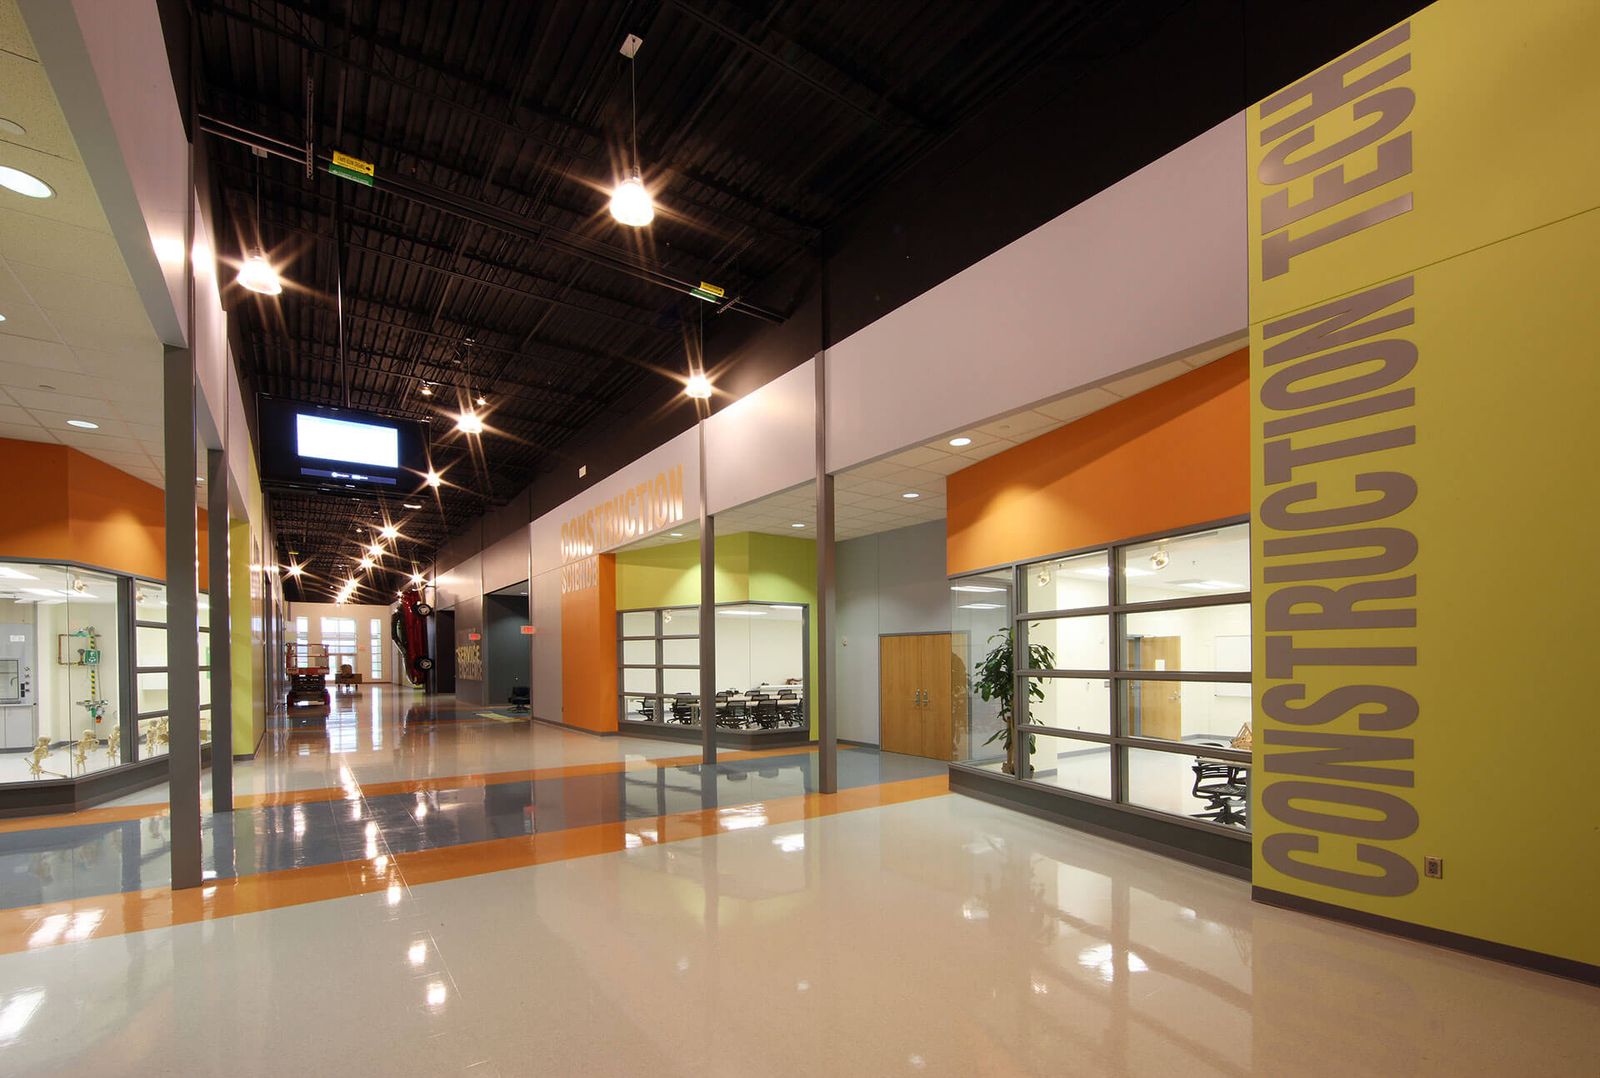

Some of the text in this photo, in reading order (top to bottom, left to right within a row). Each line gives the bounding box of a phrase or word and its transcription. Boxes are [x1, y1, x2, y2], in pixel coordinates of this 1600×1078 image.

[1257, 21, 1419, 897] CONSTRUCTION TECH
[561, 464, 683, 563] CONSTRUCTION
[456, 644, 480, 662] SERVICE
